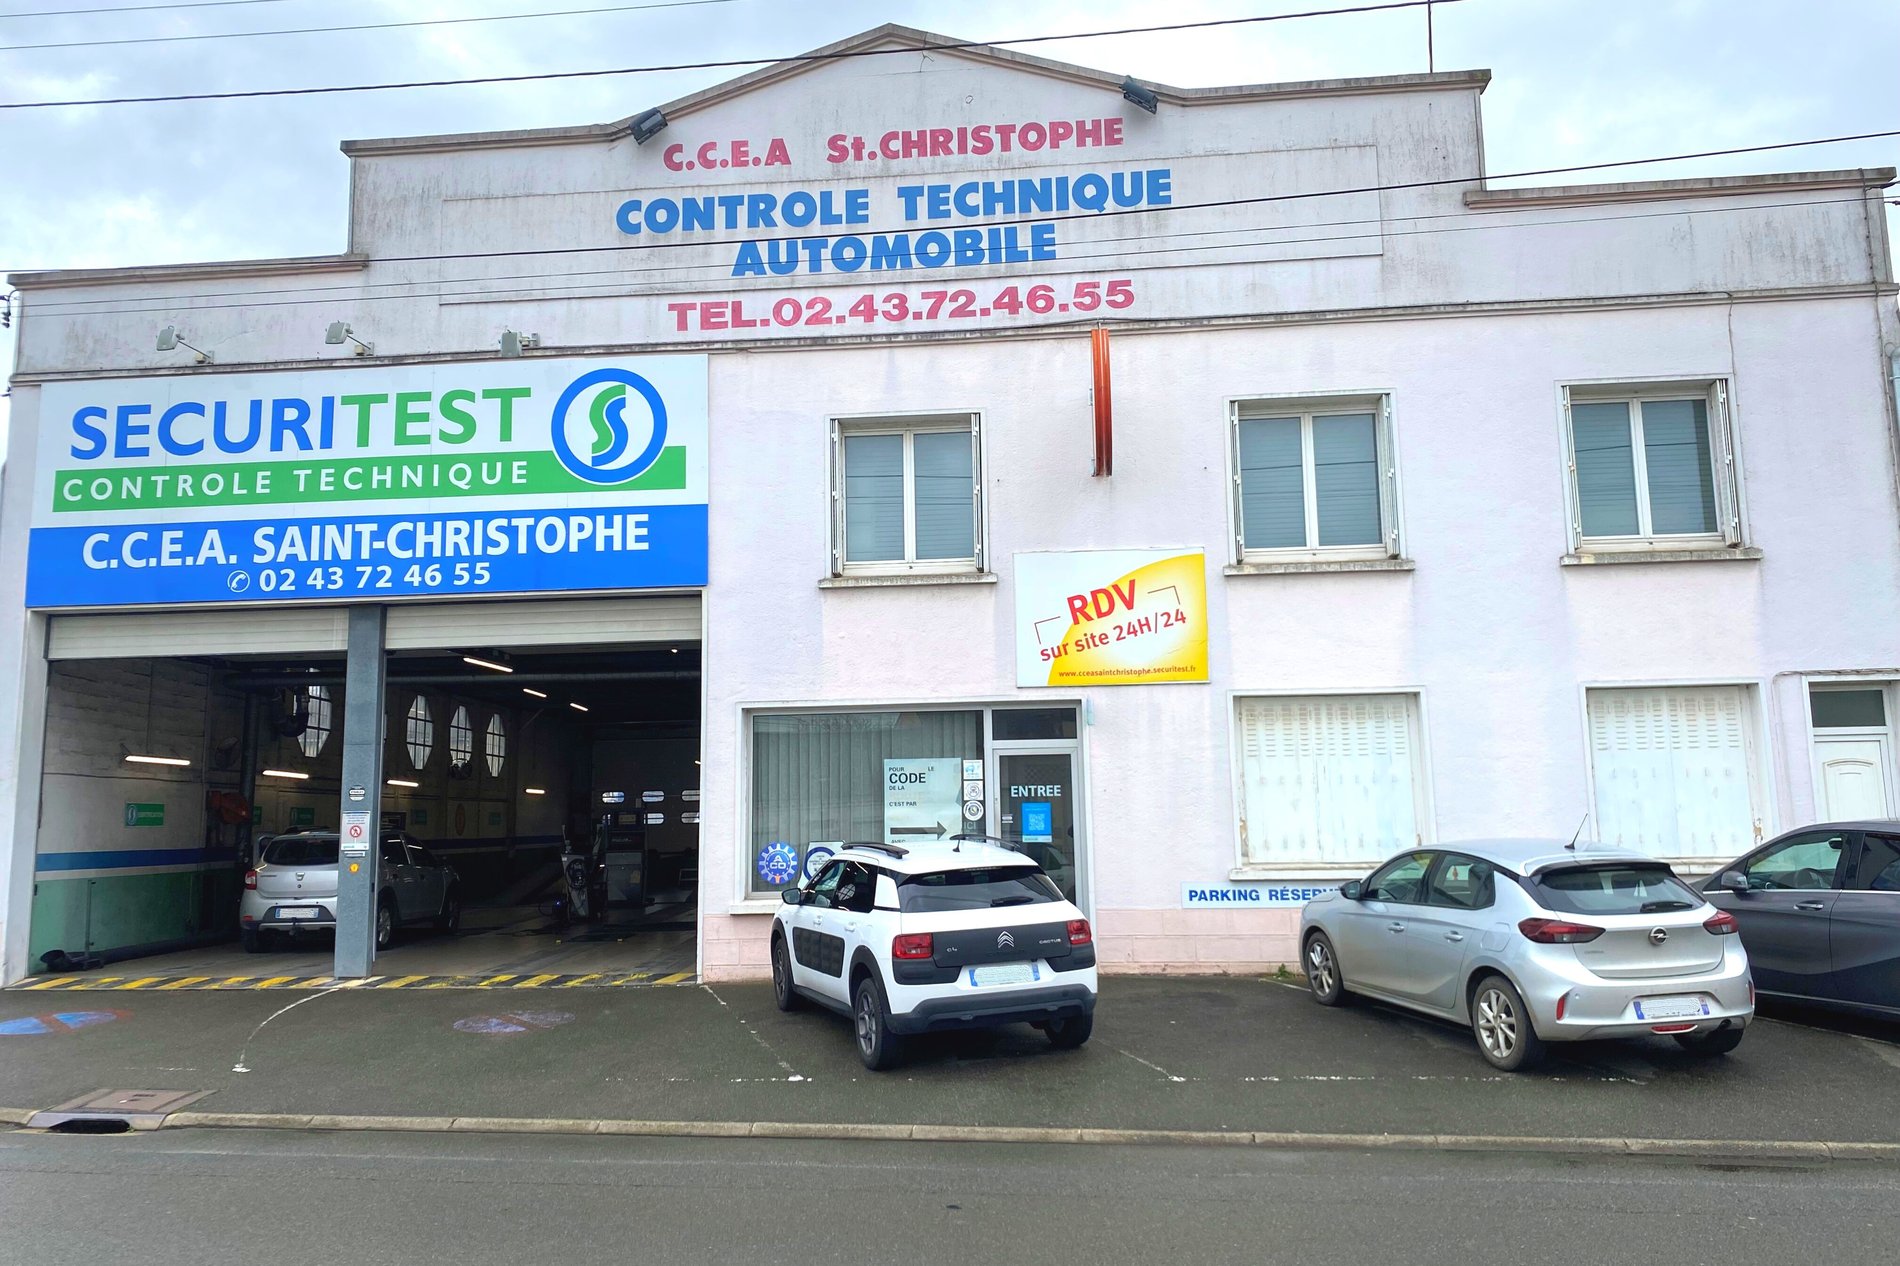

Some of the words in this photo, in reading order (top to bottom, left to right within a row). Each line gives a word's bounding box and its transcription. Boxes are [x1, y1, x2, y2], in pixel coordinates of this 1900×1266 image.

[663, 138, 791, 172] C.C.E.A
[827, 117, 1123, 163] St.CHRISTOPHE
[615, 189, 869, 235] CONTROLE
[897, 169, 1172, 220] TECHNIQUE
[731, 223, 1057, 277] AUTOMOBILE
[668, 279, 1135, 331] TEL.02.43.72.46.55
[70, 387, 532, 461] SECURITEST
[63, 471, 271, 501] CONTROLE
[293, 461, 528, 493] TECHNIQUE
[82, 529, 237, 570] C.C.E.A.
[254, 513, 649, 564] SAINT-CHRISTOPHE
[259, 568, 295, 592] 02
[307, 567, 344, 589] 43
[356, 565, 392, 588] 72
[404, 564, 442, 586] 46
[453, 562, 490, 585] 55
[1066, 579, 1136, 625] RDV
[1040, 641, 1069, 662] sur
[1074, 632, 1110, 652] site
[1112, 608, 1187, 642] 24H/24
[1058, 665, 1197, 678] www.cceasaintchristophe.securitest.fr
[889, 772, 927, 784] CODE
[1010, 785, 1062, 797] ENTREE
[963, 821, 977, 830] ICI
[1188, 889, 1260, 901] PARKING
[1268, 886, 1341, 901] RÉSER
